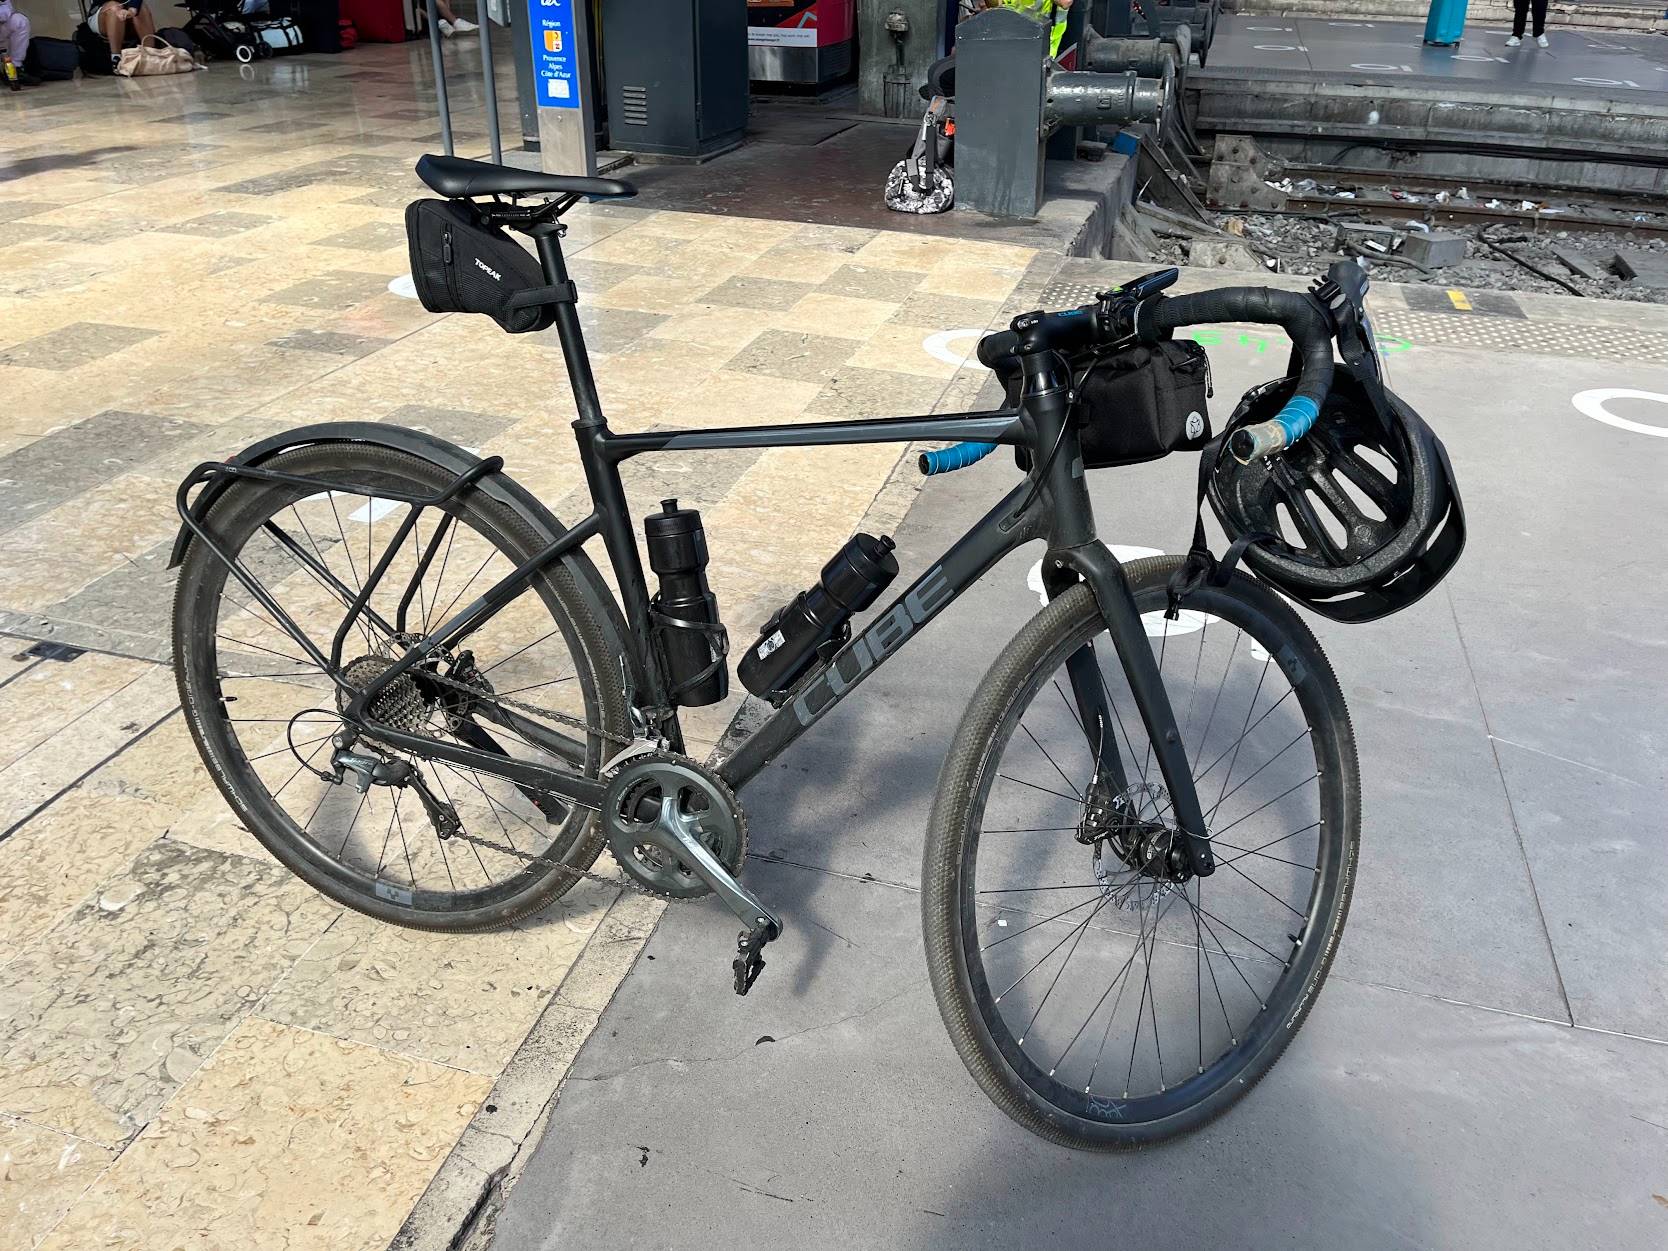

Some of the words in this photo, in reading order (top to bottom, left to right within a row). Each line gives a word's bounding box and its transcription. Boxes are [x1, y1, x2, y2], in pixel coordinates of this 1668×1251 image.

[542, 19, 561, 28] Région
[474, 257, 502, 281] TOPEAK
[793, 564, 955, 726] CUBE
